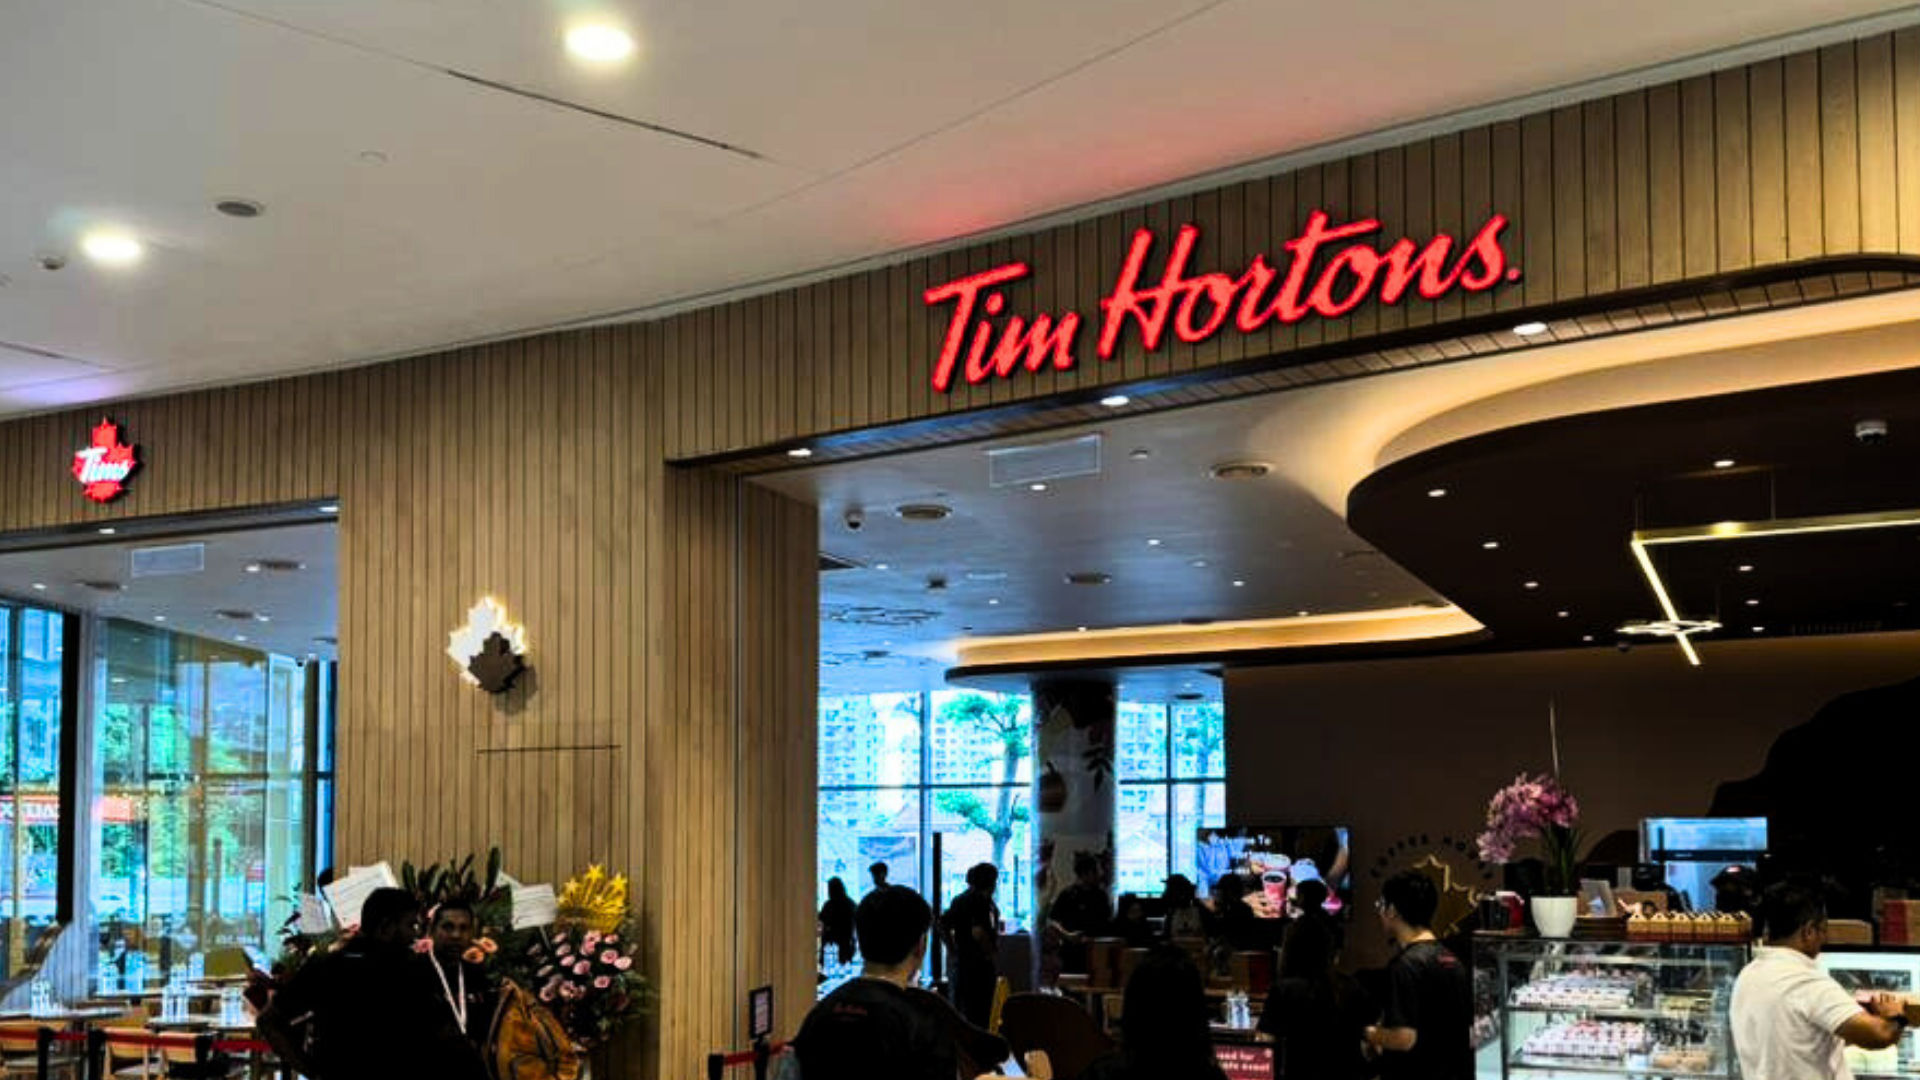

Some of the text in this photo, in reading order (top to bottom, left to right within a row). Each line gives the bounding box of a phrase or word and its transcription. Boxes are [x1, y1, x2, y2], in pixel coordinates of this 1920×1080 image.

[923, 209, 1521, 393] Tim Hortons.
[75, 446, 130, 484] Tims
